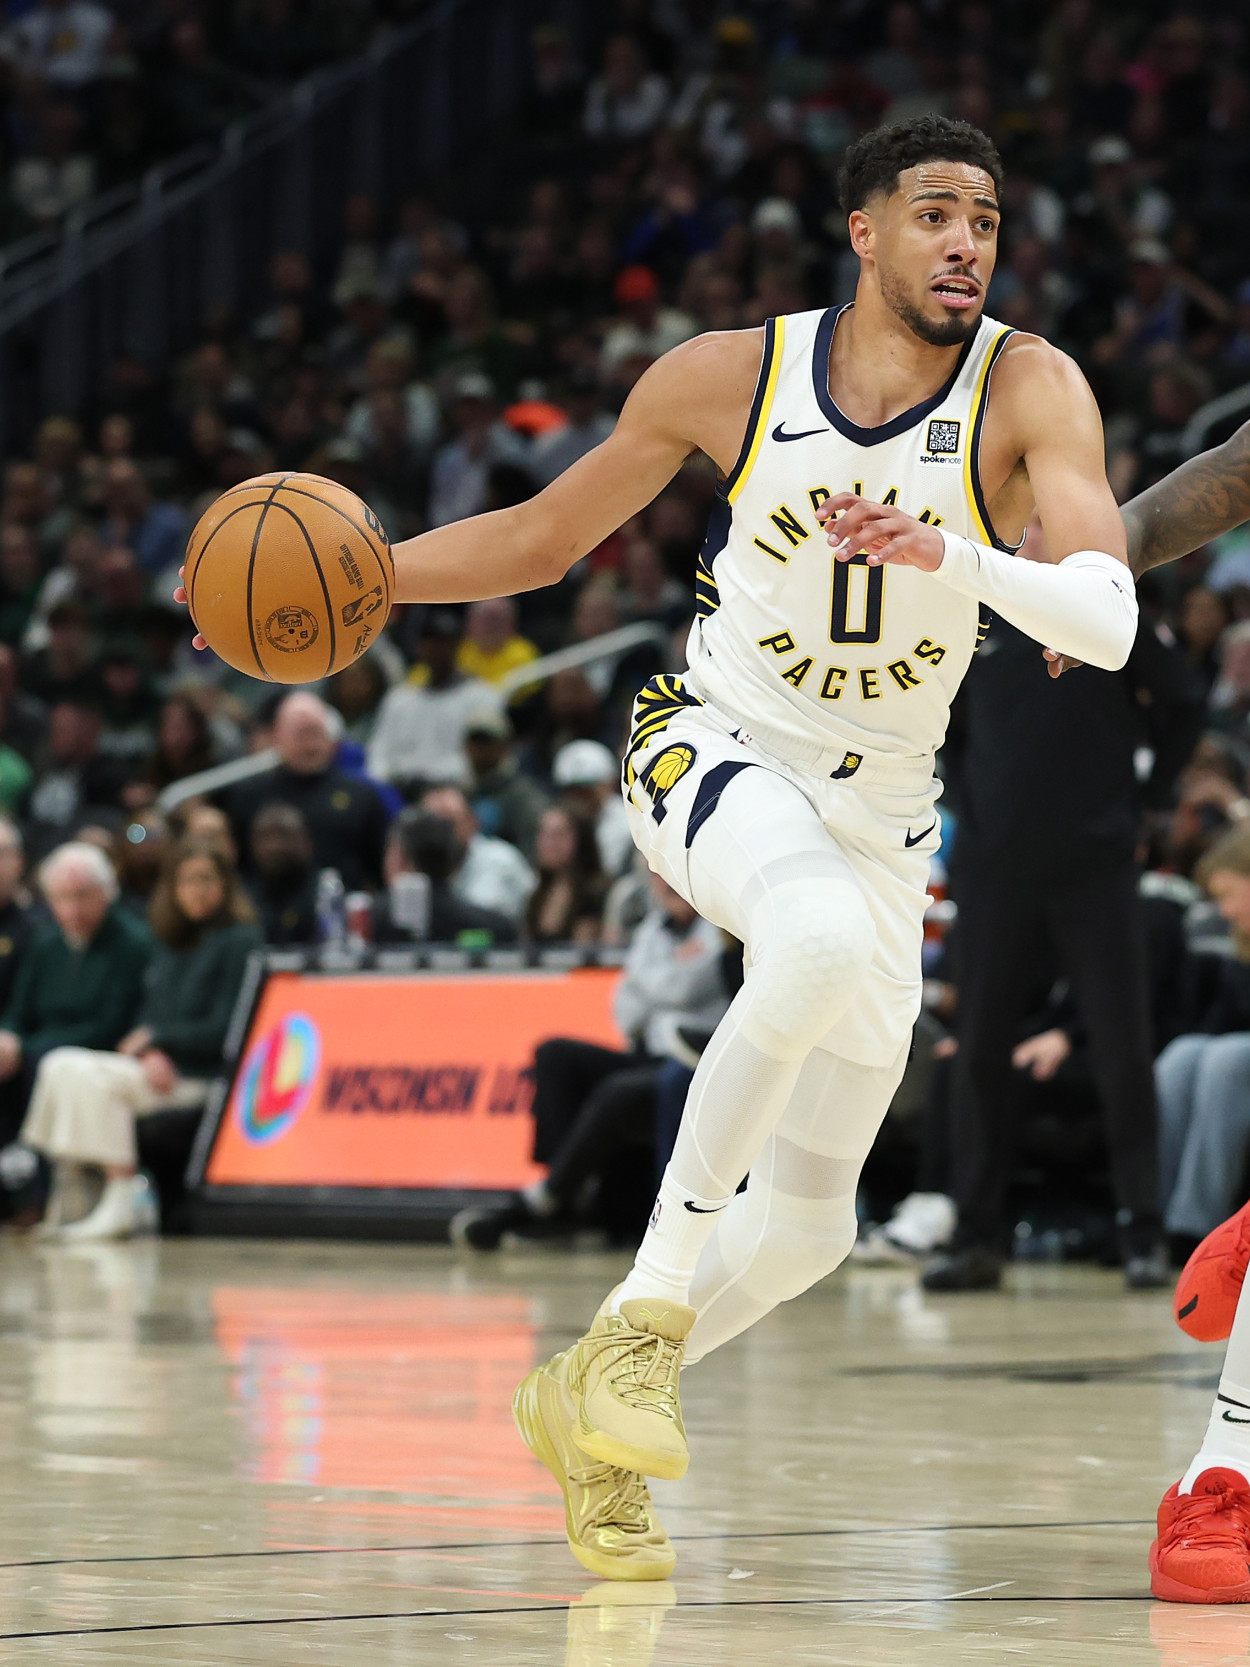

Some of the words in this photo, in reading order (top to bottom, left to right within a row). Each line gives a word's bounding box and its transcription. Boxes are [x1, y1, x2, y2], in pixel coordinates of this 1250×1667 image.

[919, 455, 962, 464] spokenote
[753, 480, 945, 566] INDA
[828, 551, 887, 646] 0
[757, 629, 948, 701] PACERS
